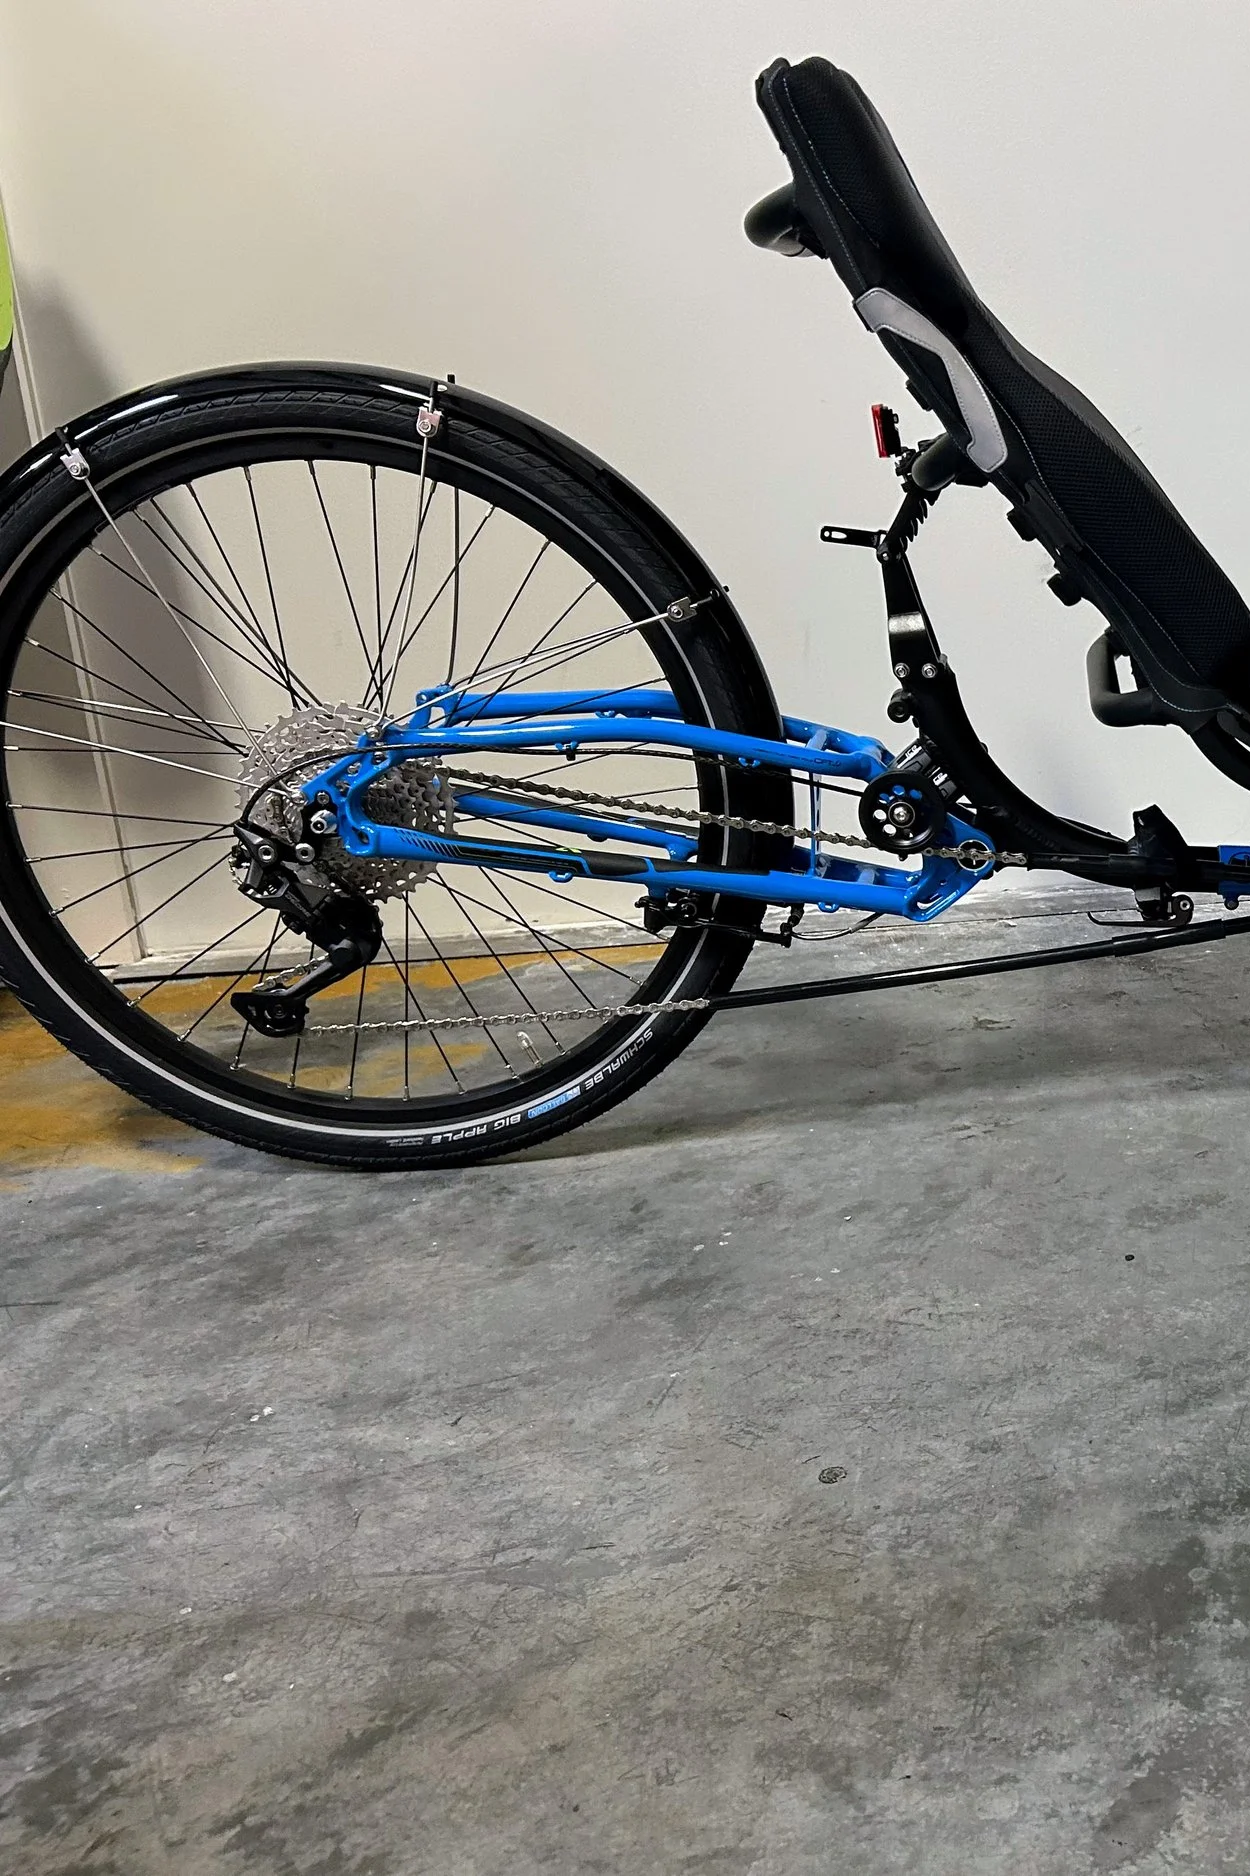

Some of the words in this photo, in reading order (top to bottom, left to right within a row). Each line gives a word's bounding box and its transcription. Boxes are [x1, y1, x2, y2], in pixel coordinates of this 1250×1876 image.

[584, 1028, 653, 1091] SCHWALBE
[494, 1113, 521, 1131] BIG
[431, 1124, 487, 1145] APPLE
